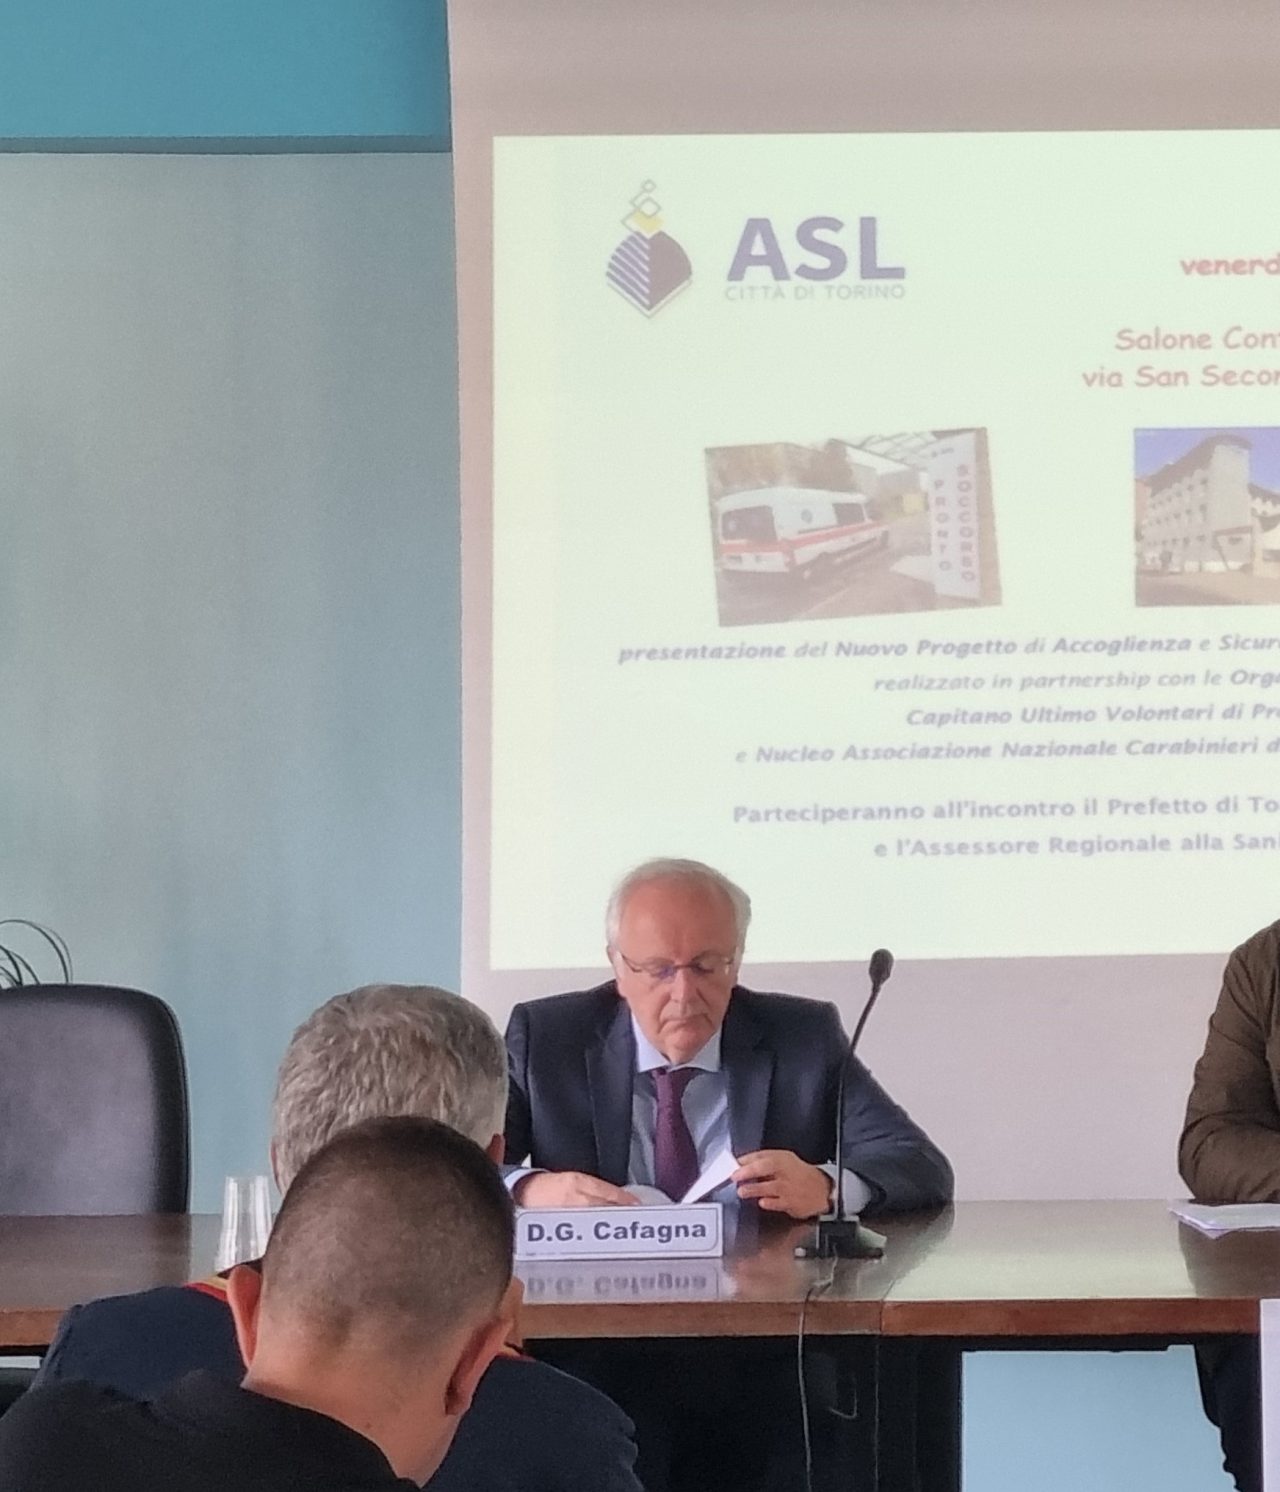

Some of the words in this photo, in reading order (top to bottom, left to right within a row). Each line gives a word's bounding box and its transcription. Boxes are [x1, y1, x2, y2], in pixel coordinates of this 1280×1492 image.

[727, 216, 906, 282] ASL
[794, 285, 815, 300] DI
[824, 284, 907, 300] TORINO
[1115, 326, 1212, 351] Salone
[1082, 366, 1123, 388] via
[1134, 365, 1189, 388] San
[618, 642, 785, 665] presentazione
[795, 641, 828, 657] del
[835, 642, 908, 657] Nuovo
[917, 639, 1017, 660] Progetto
[1024, 637, 1044, 653] di
[1052, 635, 1191, 657] Accoglienza
[1199, 639, 1210, 651] e
[875, 675, 985, 691] realizzato
[993, 673, 1012, 688] in
[1020, 671, 1150, 692] partnership
[1158, 674, 1195, 686] con
[1204, 669, 1221, 685] le
[906, 708, 1012, 728] Capitano
[1021, 706, 1096, 723] Ultimo
[1106, 704, 1213, 721] Volontari
[1222, 703, 1244, 719] di
[736, 751, 746, 763] e
[756, 746, 834, 762] Nucleo
[842, 743, 991, 760] Associazione
[1002, 740, 1117, 757] Nazionale
[1125, 737, 1258, 755] Carabinieri
[733, 804, 925, 824] Parteciperanno
[933, 801, 1075, 818] all'incontro
[1084, 798, 1097, 815] il
[1108, 797, 1207, 815] Prefetto
[1216, 796, 1238, 813] di
[874, 844, 887, 857] e
[897, 839, 1039, 856] l'Assessore
[1049, 834, 1170, 857] Regionale
[1181, 833, 1223, 850] alla
[527, 1222, 583, 1242] D.G.
[593, 1221, 706, 1243] Cafagna
